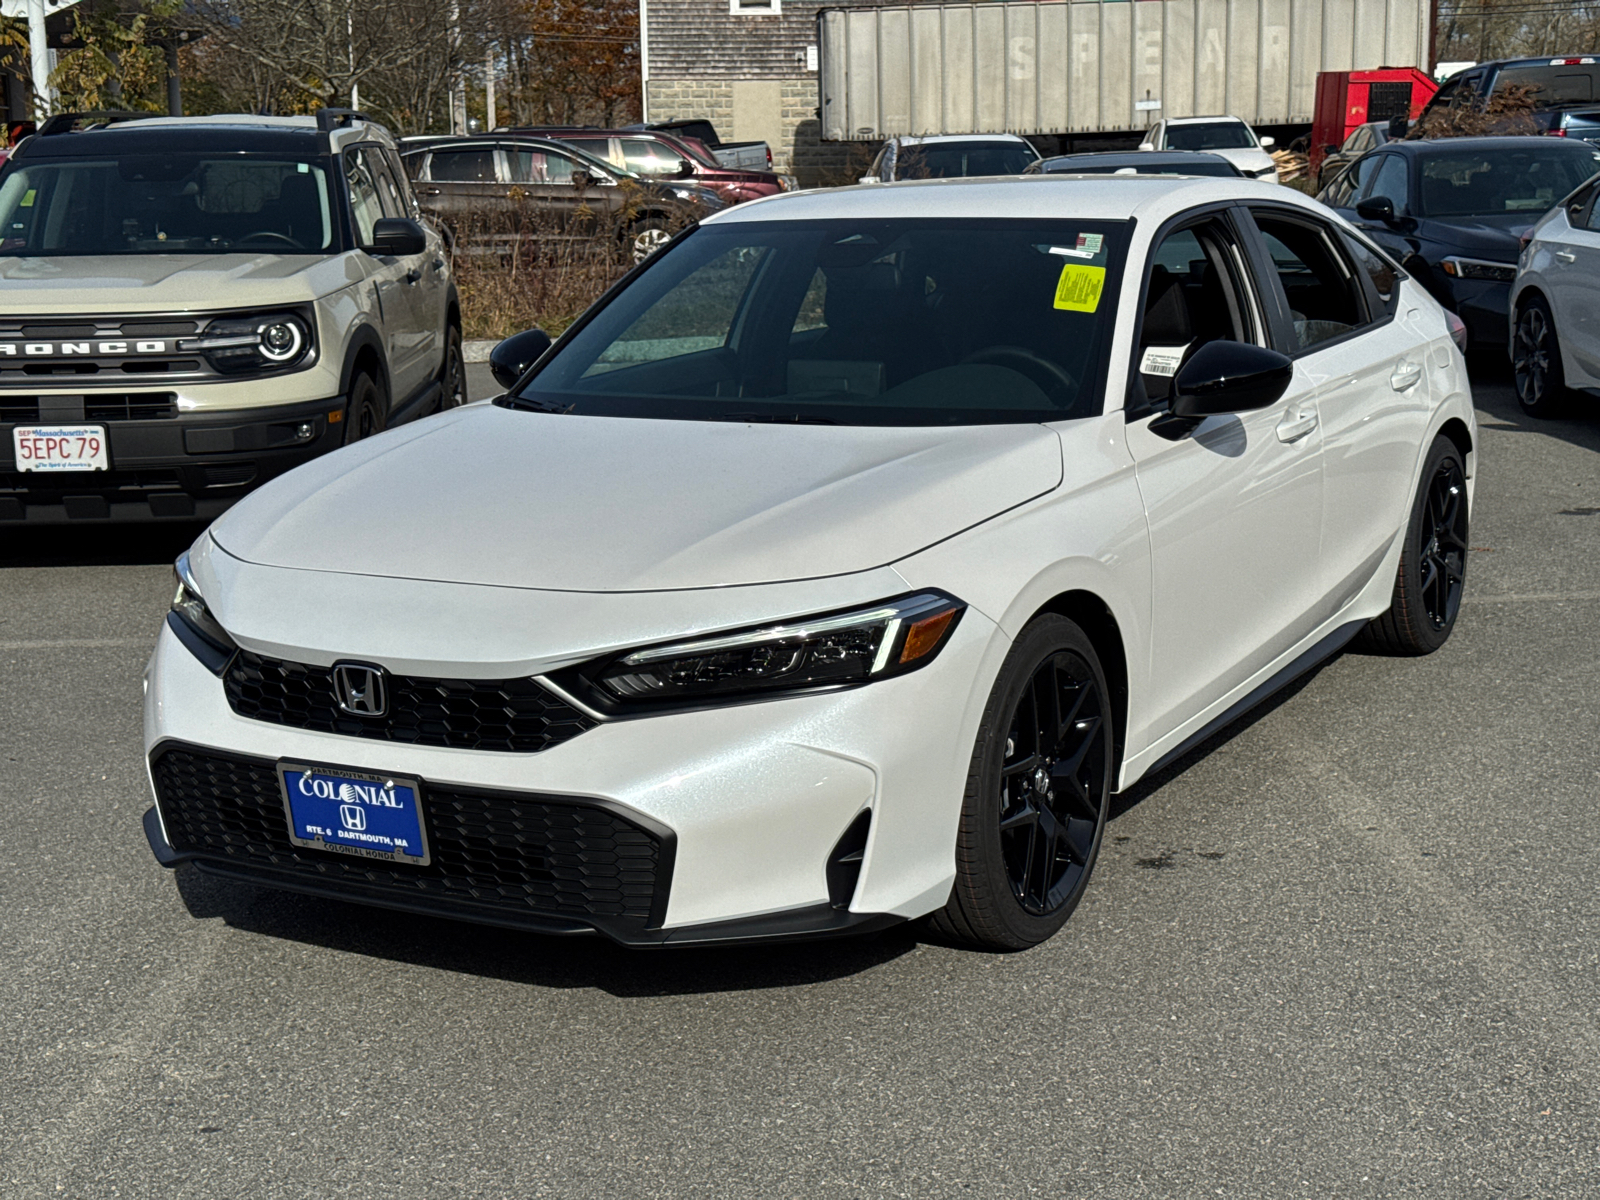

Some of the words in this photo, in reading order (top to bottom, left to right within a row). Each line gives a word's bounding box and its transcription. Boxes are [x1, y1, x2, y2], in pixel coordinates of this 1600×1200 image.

[1008, 26, 1288, 80] SPEAR
[35, 429, 85, 437] Massachusetts
[20, 438, 70, 459] 5EPC
[76, 437, 100, 459] 79
[299, 777, 403, 808] COLONIAL
[306, 825, 326, 835] RTE.
[326, 828, 333, 836] 6
[338, 830, 393, 846] DARTMOUTH,
[394, 838, 408, 847] MA
[324, 844, 364, 855] COLONIAL
[365, 850, 396, 860] HONDA
